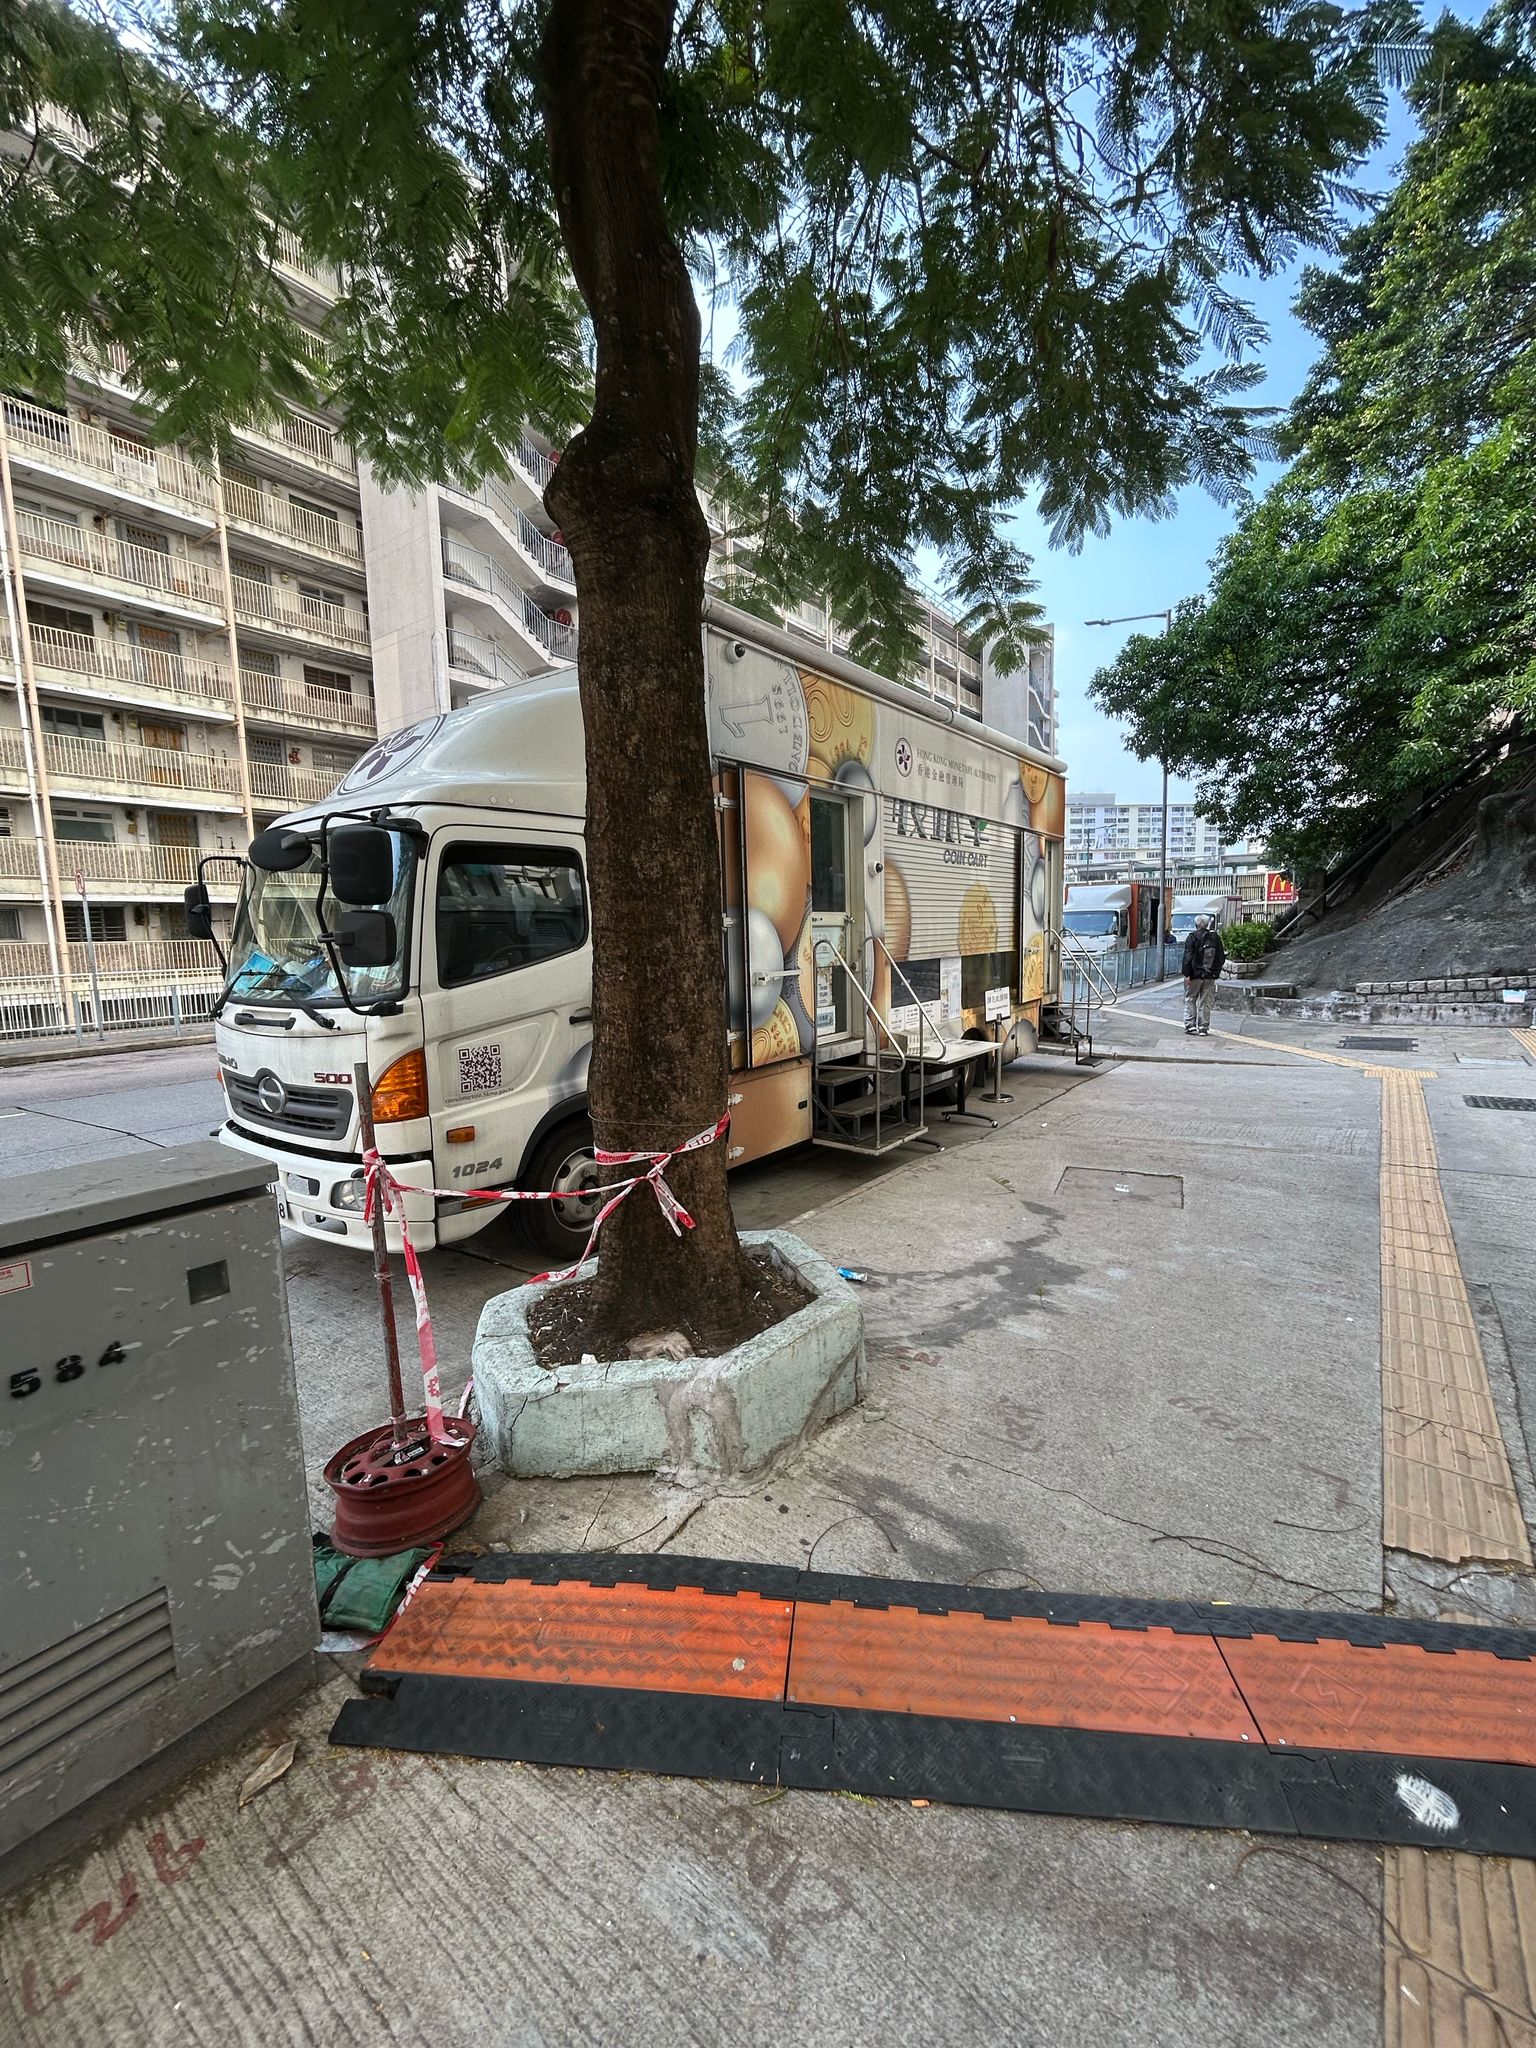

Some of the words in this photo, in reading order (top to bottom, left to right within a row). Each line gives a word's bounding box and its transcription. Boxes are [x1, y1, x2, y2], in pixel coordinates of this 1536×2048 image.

[916, 747, 933, 764] HONG
[933, 753, 948, 769] KONG
[943, 849, 966, 866] COIN
[967, 852, 989, 869] CART
[314, 1072, 353, 1085] 500
[452, 1157, 503, 1178] 1024
[9, 1340, 127, 1398] 584
